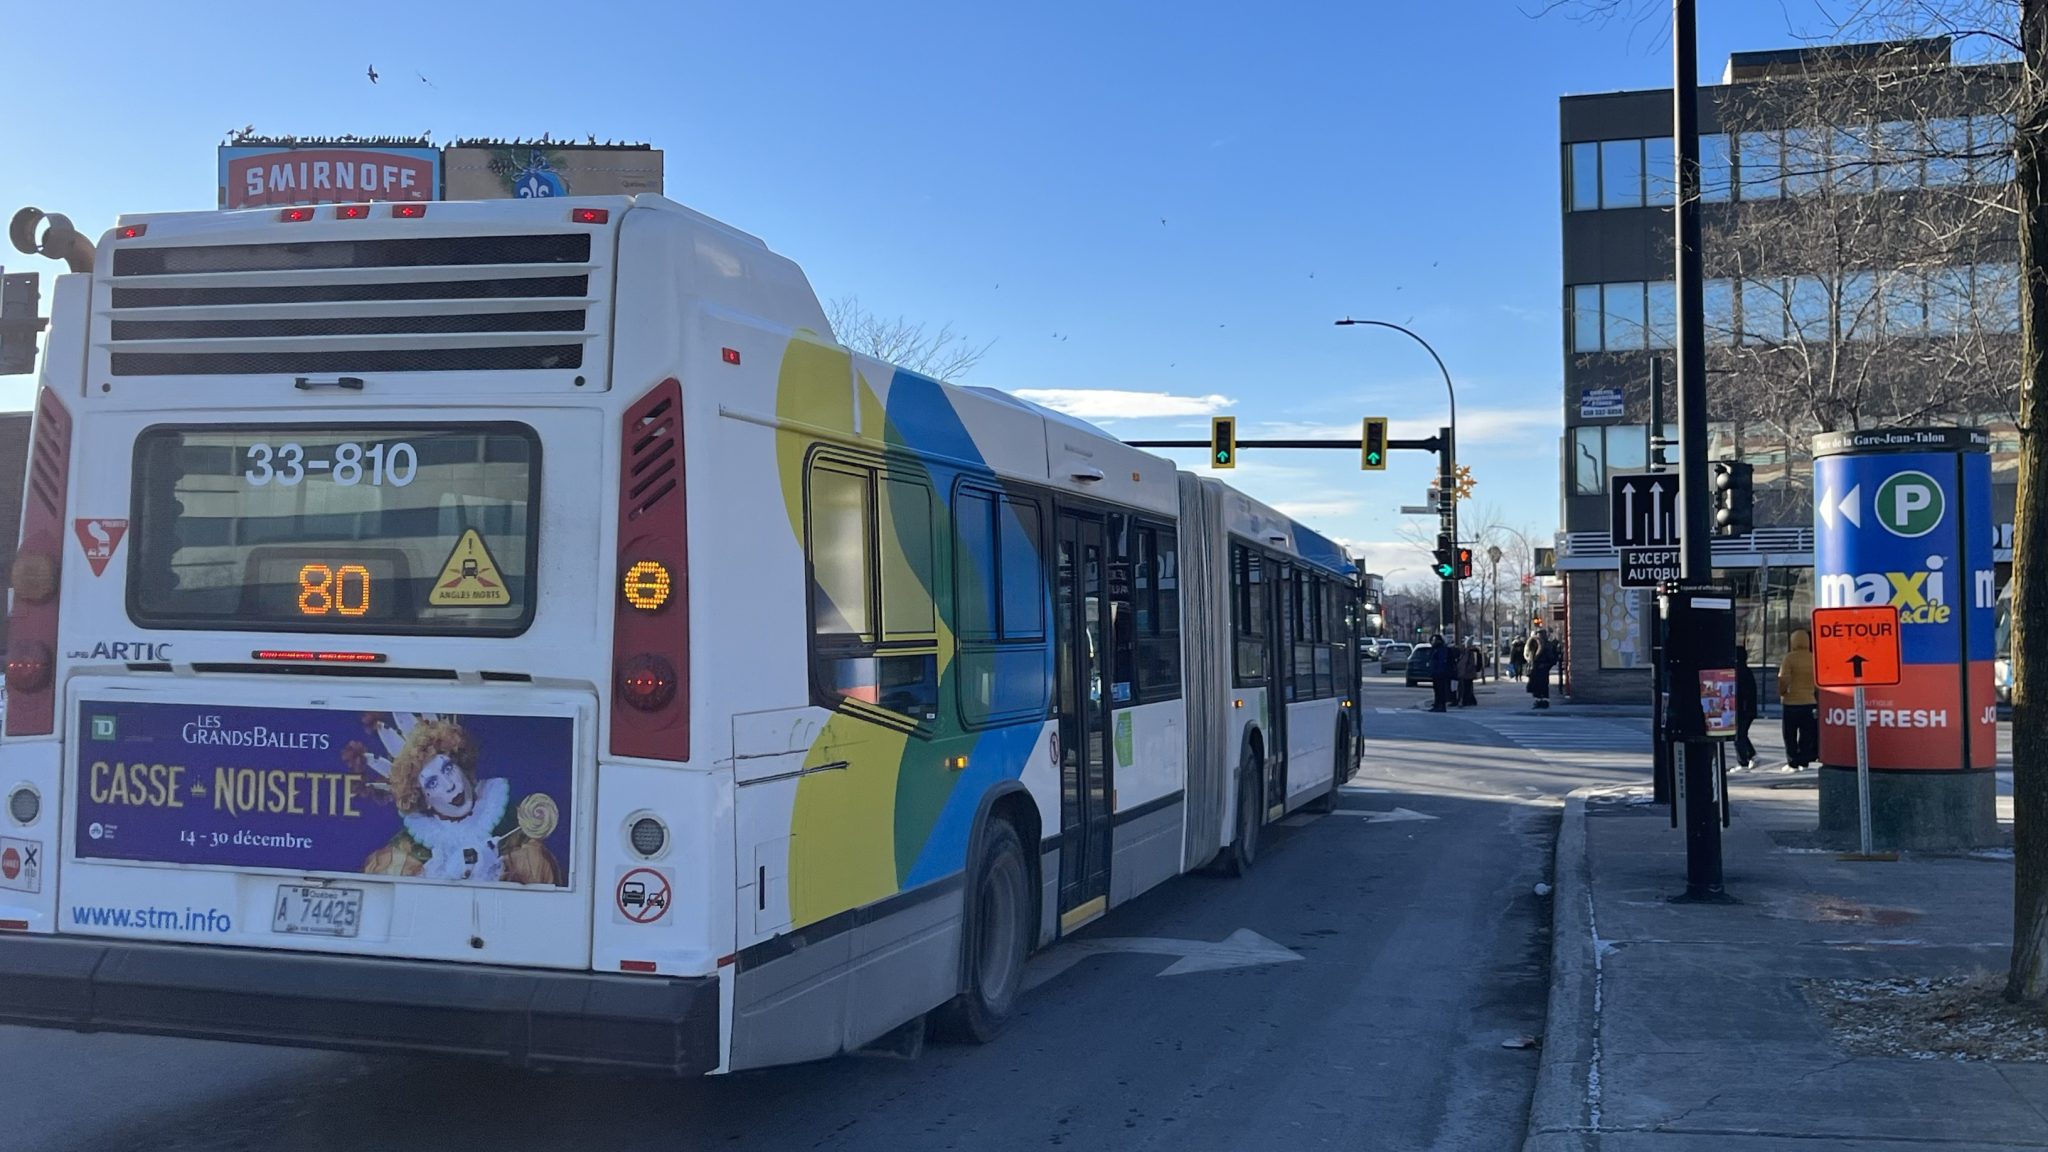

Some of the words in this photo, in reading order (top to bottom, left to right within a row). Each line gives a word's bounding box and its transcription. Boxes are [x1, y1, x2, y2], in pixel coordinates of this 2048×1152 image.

[246, 161, 416, 196] SMIRNOFF
[1832, 437, 1842, 448] de
[1843, 436, 1852, 447] la
[1854, 432, 1945, 446] Gare-Jean-Talon
[245, 442, 418, 487] 33-810
[1895, 484, 1931, 526] P
[1629, 551, 1681, 566] EXCEPT
[1628, 567, 1680, 580] AUTOBU
[1821, 555, 1944, 609] maxi
[298, 563, 370, 615] 80
[1820, 621, 1892, 638] DÉTOUR
[90, 641, 174, 661] ARTIC
[197, 715, 221, 728] LES
[1825, 708, 1857, 727] JOE
[1865, 709, 1947, 728] FRESH
[1981, 706, 1996, 724] JO
[94, 719, 114, 736] TD
[90, 761, 185, 808] CASSE
[214, 767, 362, 818] NOISETTE
[180, 831, 196, 846] 14
[210, 832, 229, 846] 30
[233, 830, 313, 849] décembre
[72, 906, 232, 933] www.stm.info
[277, 896, 288, 921] A
[301, 898, 358, 926] 74425
